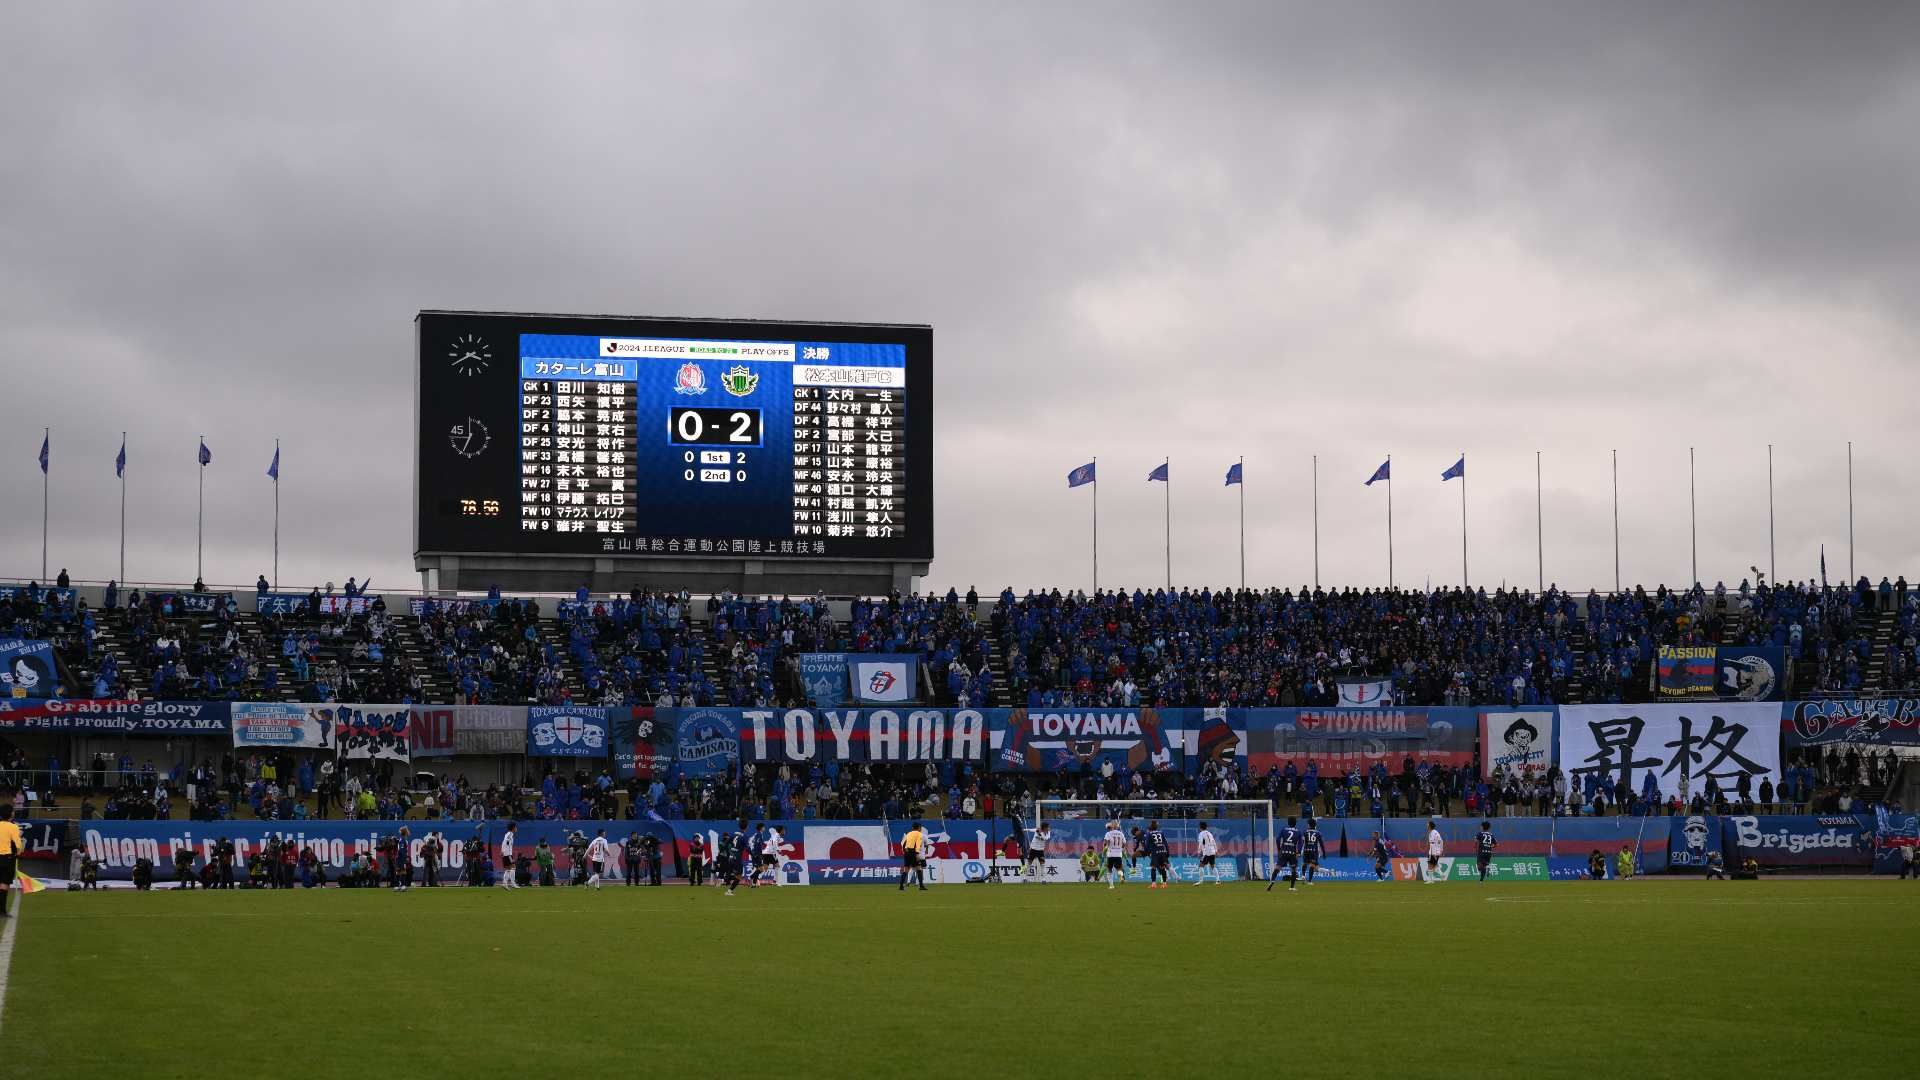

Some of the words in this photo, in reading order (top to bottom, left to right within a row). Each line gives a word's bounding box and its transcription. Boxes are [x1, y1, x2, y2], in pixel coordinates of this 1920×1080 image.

[803, 347, 829, 360] 決勝
[535, 362, 624, 377] カターレ富山
[805, 368, 892, 383] 松本山雅FC
[524, 382, 537, 391] GK
[543, 383, 548, 391] 1
[558, 382, 584, 393] 田川
[597, 382, 625, 394] 知樹
[795, 389, 808, 397] GK
[826, 389, 853, 400] 大内
[866, 390, 892, 401] 一生
[524, 396, 538, 404] DF
[541, 396, 551, 405] 23
[557, 396, 585, 407] 西矢
[524, 410, 538, 418] DF
[543, 410, 549, 418] 2
[795, 403, 808, 411] DF
[811, 403, 821, 411] 44
[827, 402, 861, 414] 野々村
[679, 411, 703, 441] 0
[729, 412, 752, 441] 2
[795, 416, 808, 424] DF
[866, 416, 892, 428] 祥平
[450, 425, 464, 434] 45
[523, 424, 538, 432] DF
[542, 424, 549, 432] 4
[557, 424, 584, 435] 神山
[597, 424, 625, 436] 京右
[795, 430, 808, 438] DF
[813, 430, 819, 438] 2
[866, 430, 892, 442] 大己
[523, 438, 538, 446] DF
[541, 438, 550, 446] 25
[557, 437, 585, 449] 安光
[795, 444, 808, 452] DF
[812, 444, 820, 452] 17
[828, 443, 854, 455] 山本
[523, 452, 537, 460] MF
[541, 452, 550, 460] 33
[684, 451, 694, 462] 0
[707, 453, 724, 462] 1st
[736, 452, 746, 463] 2
[795, 457, 808, 465] MF
[812, 458, 821, 466] 15
[828, 457, 854, 468] 山本
[866, 457, 892, 469] 康裕
[523, 465, 537, 473] MF
[541, 466, 550, 474] 16
[557, 465, 584, 476] 末木
[597, 465, 624, 477] 裕也
[684, 469, 694, 480] 0
[704, 471, 726, 480] 2nd
[736, 470, 747, 482] 0
[795, 471, 808, 479] MF
[811, 471, 821, 479] 46
[827, 470, 854, 482] 安永
[866, 471, 892, 482] 玲央
[523, 479, 537, 487] FW
[541, 479, 550, 487] 27
[557, 479, 589, 490] 吉平
[795, 484, 808, 493] MF
[811, 485, 821, 493] 40
[866, 484, 892, 496] 大輝
[523, 493, 537, 501] MF
[541, 493, 550, 502] 18
[557, 492, 584, 504] 伊藤
[597, 493, 624, 505] 拓巳
[795, 498, 808, 506] FW
[828, 498, 854, 509] 村越
[523, 507, 537, 515] FW
[541, 507, 550, 516] 10
[557, 507, 588, 517] マテウス
[595, 507, 624, 518] レイリア
[795, 512, 808, 520] FW
[812, 512, 820, 520] 11
[828, 511, 853, 523] 浅川
[523, 521, 537, 529] FW
[542, 521, 549, 529] 9
[597, 521, 624, 532] 聖生
[795, 526, 808, 534] FW
[813, 526, 821, 534] 10
[828, 525, 854, 536] 菊井
[866, 525, 893, 537] 悠介
[602, 538, 826, 554] 富山県総合運動公園陸上競技場
[1659, 647, 1716, 659] PASSION
[801, 664, 847, 673] TOYAMA
[107, 701, 142, 714] the
[144, 701, 203, 717] glory
[24, 716, 70, 728] Fight
[143, 718, 225, 729] TOYAMA
[1028, 713, 1142, 736] TOYAMA
[1324, 710, 1406, 733] TOYAMA
[411, 710, 454, 752] NO
[742, 709, 983, 760] TOYAMA
[1569, 716, 1772, 795] 昇格
[1151, 833, 1163, 843] 33
[1287, 831, 1294, 842] 2
[1307, 832, 1317, 842] 16
[1482, 834, 1492, 844] 23
[1731, 815, 1854, 853] Brigada
